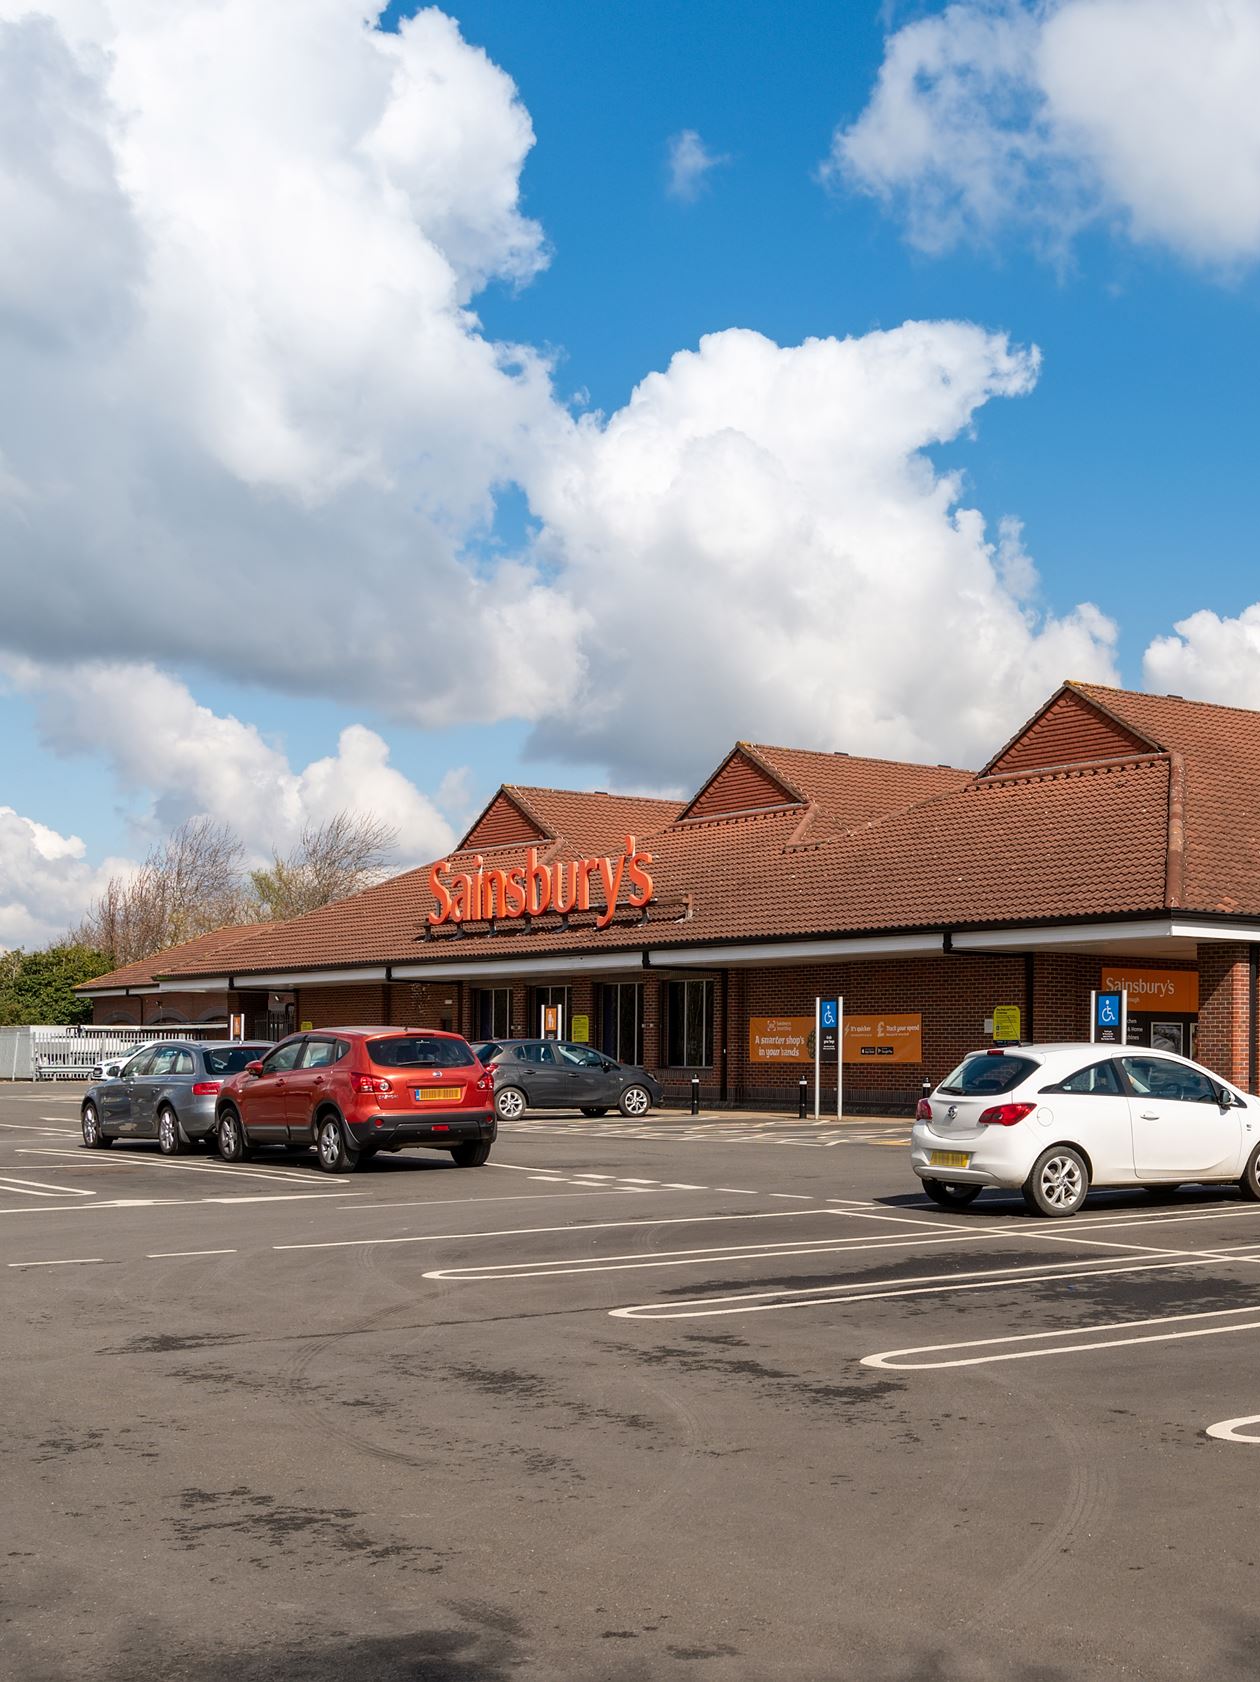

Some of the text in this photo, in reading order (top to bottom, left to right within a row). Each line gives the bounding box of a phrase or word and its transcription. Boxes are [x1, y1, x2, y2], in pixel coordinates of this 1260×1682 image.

[428, 834, 654, 928] Sainsbury's
[1105, 977, 1175, 998] Sainsbury's
[755, 1035, 805, 1047] A smarter shop's
[758, 1047, 800, 1058] in your hands
